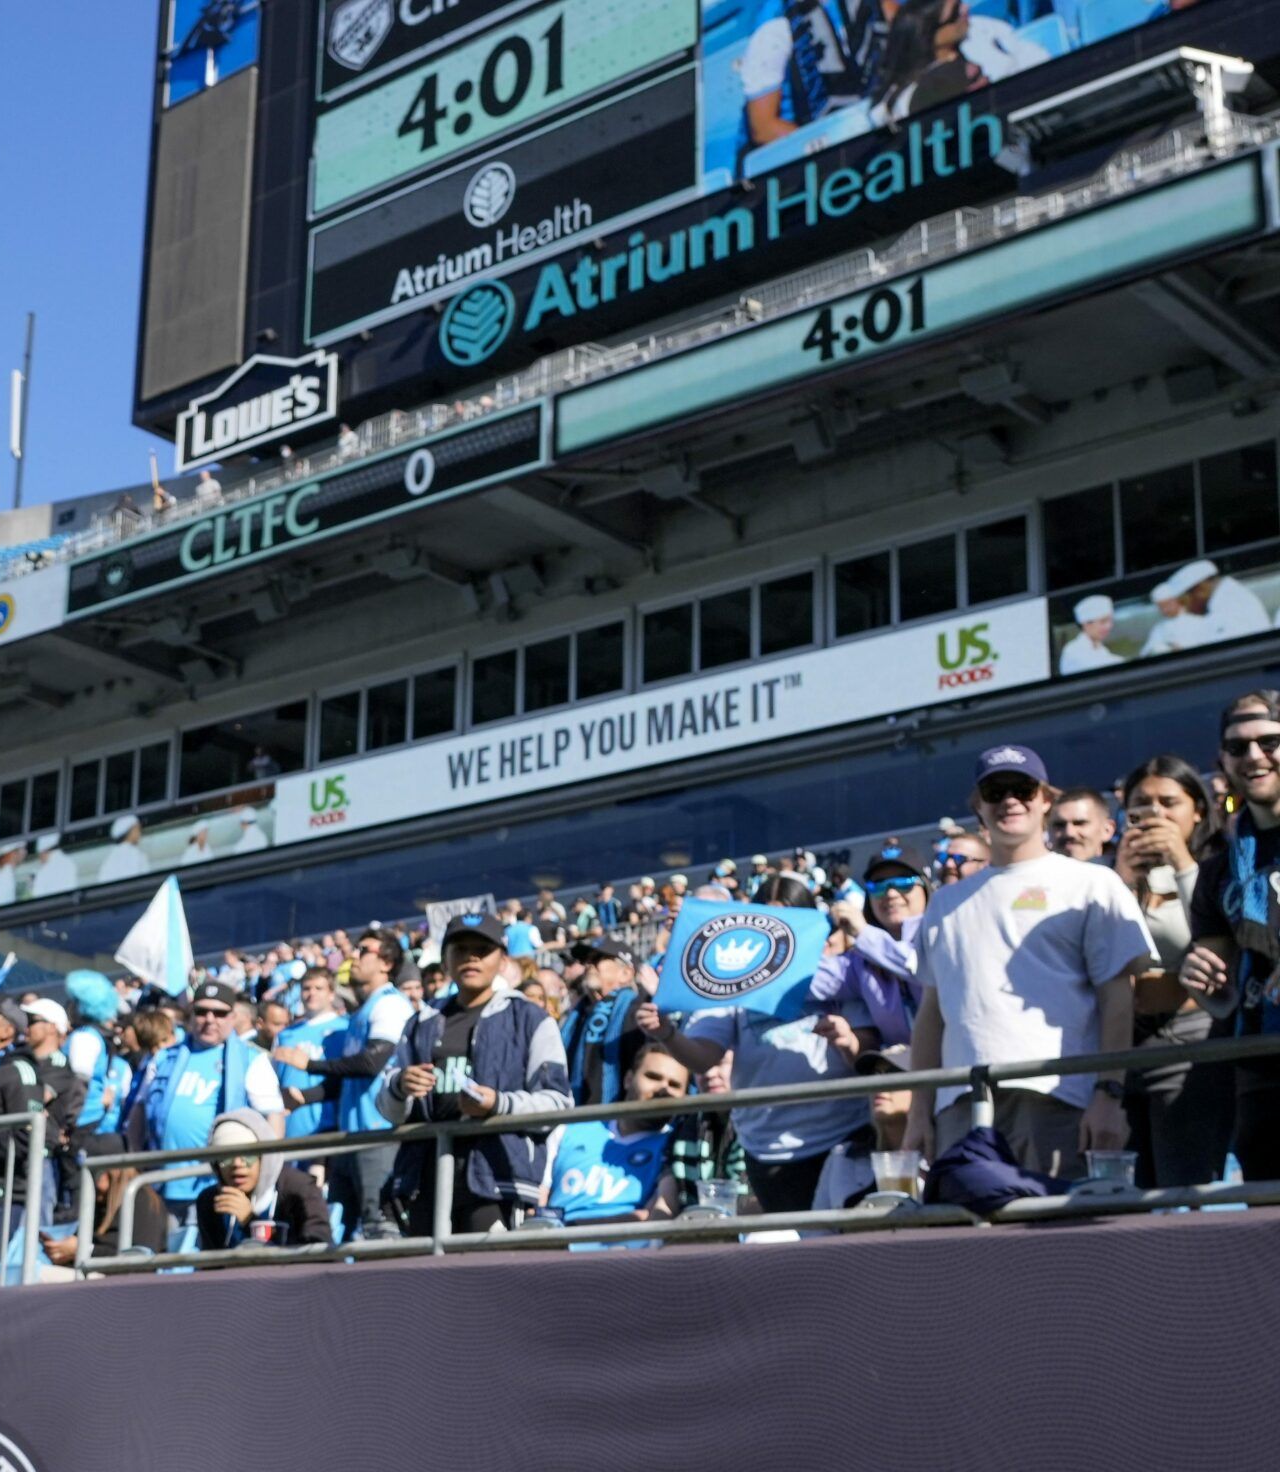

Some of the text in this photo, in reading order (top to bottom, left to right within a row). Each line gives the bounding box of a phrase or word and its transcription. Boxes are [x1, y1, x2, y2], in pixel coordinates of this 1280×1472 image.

[397, 11, 565, 153] 4:01
[391, 197, 593, 304] Atrium Health
[523, 102, 1003, 332] Atrium Health
[802, 277, 926, 362] 4:01
[191, 374, 320, 457] LOWE'S
[180, 449, 435, 571] CLTFC 0
[938, 665, 993, 690] FOODS
[448, 745, 490, 789] WE
[499, 727, 570, 779] HELP
[579, 711, 636, 760] YOU
[647, 687, 740, 745] MAKE
